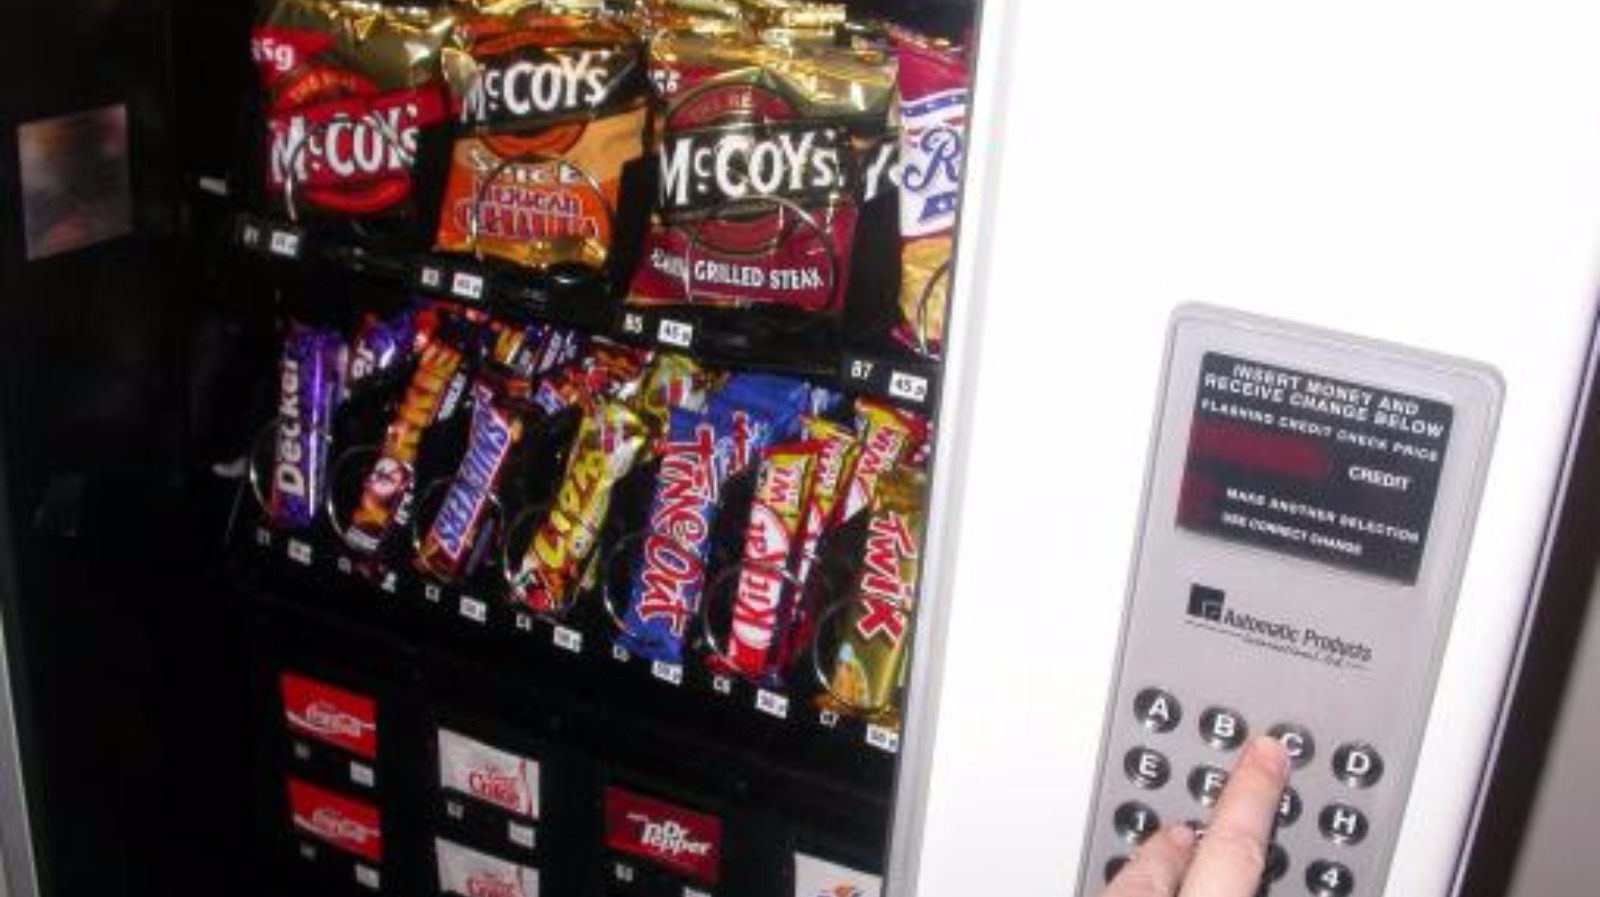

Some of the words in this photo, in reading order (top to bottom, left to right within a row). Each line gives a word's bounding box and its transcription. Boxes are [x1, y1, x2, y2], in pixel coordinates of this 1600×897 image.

[694, 259, 765, 288] GRILLED
[769, 268, 825, 292] STEAK
[1232, 363, 1302, 390] INSERT
[1306, 378, 1375, 406] MONEY
[1377, 394, 1420, 416] AND
[1204, 371, 1285, 403] RECEIVE
[1289, 391, 1368, 421] CHANGE
[1373, 409, 1444, 437] BELOW
[278, 358, 305, 497] Decker
[1201, 397, 1275, 425] FLASHING
[1279, 415, 1332, 438] CREDIT
[1336, 428, 1387, 452] CHECK
[1392, 441, 1438, 462] PRICE
[1348, 464, 1410, 491] CREDIT
[1226, 486, 1266, 506] MAKE
[1268, 497, 1338, 524] ANOTHER
[1339, 513, 1420, 544] SELECTION
[1222, 511, 1247, 529] USE
[1309, 531, 1363, 556] CHANGE
[1223, 608, 1300, 643] Automatic
[1302, 628, 1372, 662] Products
[1149, 695, 1170, 720] A
[1213, 714, 1236, 738] B
[1280, 732, 1304, 757] C
[1138, 754, 1159, 777] E
[1345, 751, 1370, 775] D
[1203, 773, 1224, 795] F
[1332, 808, 1357, 833] H
[1321, 866, 1340, 890] 4
